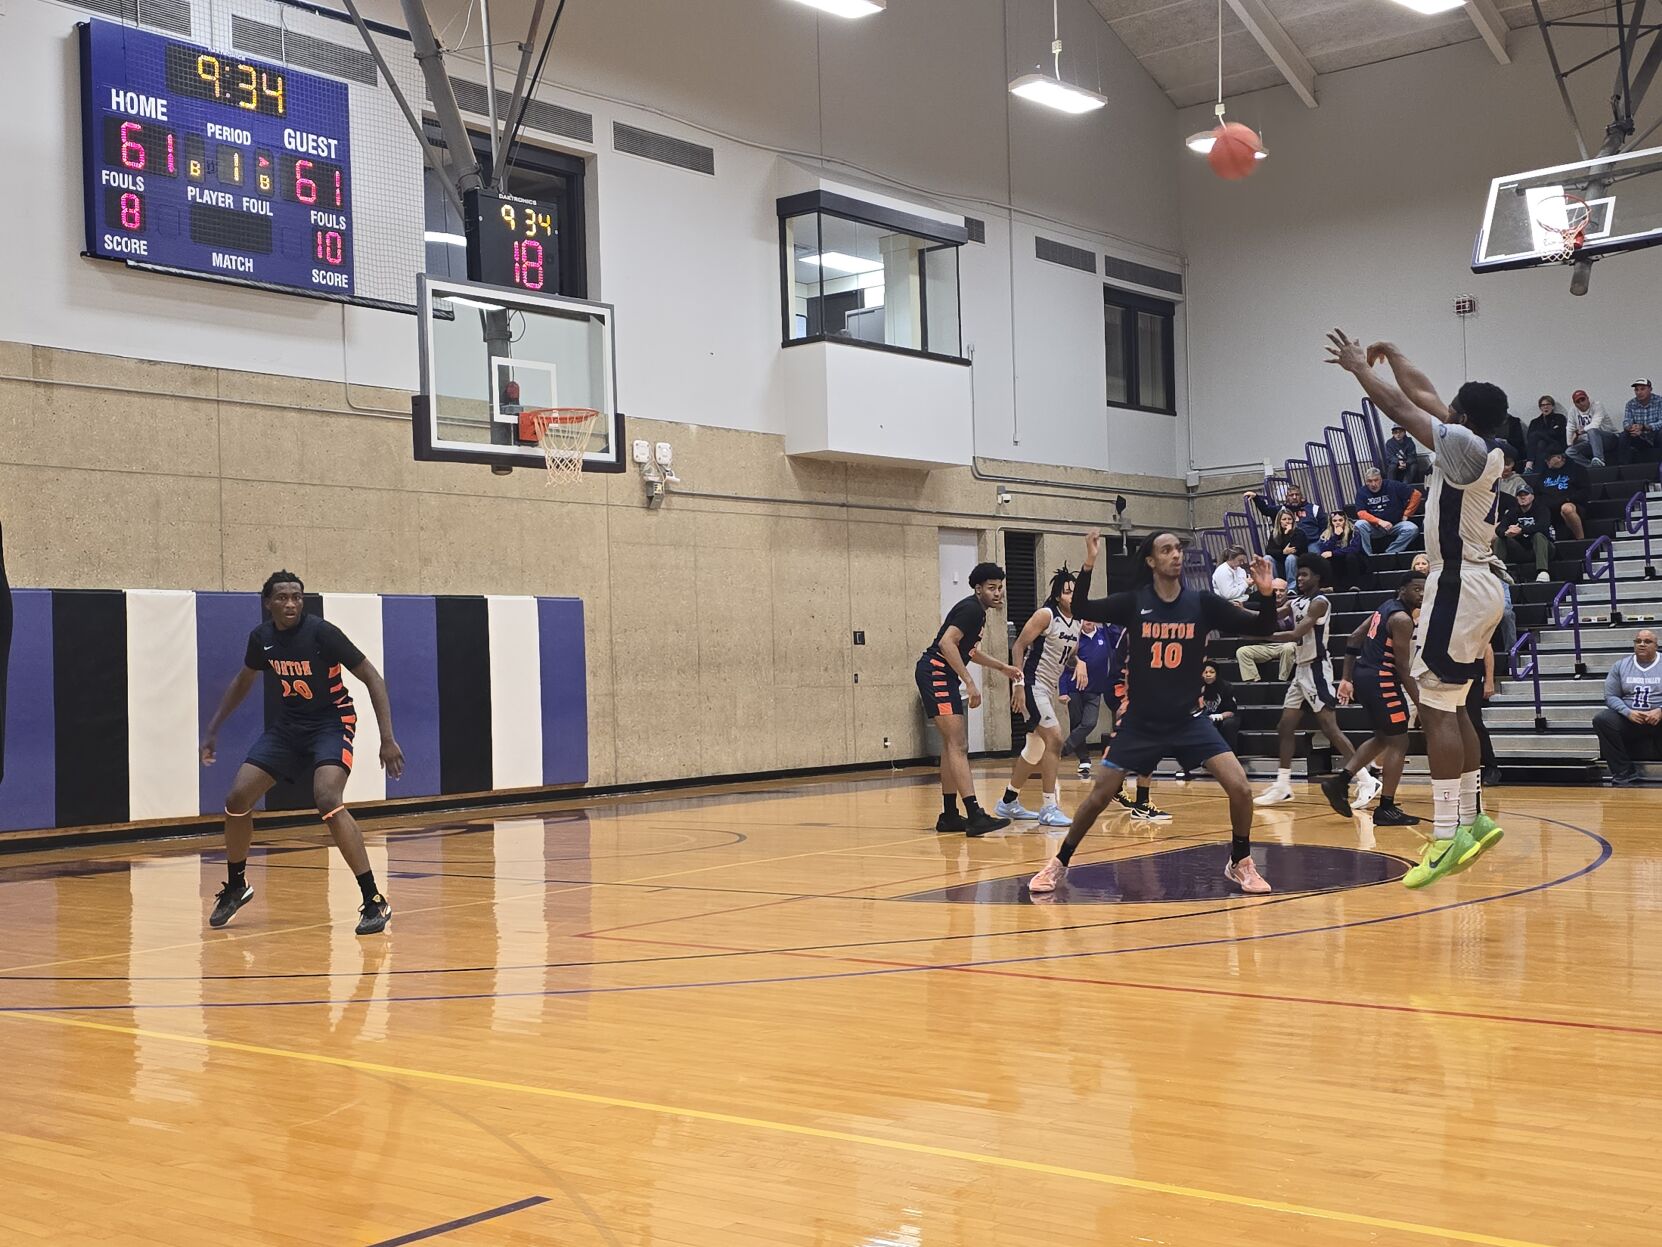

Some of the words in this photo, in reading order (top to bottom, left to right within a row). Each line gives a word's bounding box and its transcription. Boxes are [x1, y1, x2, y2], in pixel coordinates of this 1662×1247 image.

[197, 54, 283, 113] 9:34
[111, 88, 168, 121] HOME
[121, 121, 175, 173] 61
[207, 122, 251, 146] PERIOD
[284, 128, 338, 159] GUEST
[101, 169, 145, 192] FOULS
[190, 159, 201, 177] B
[233, 152, 240, 182] 1
[259, 174, 270, 190] B
[295, 159, 341, 206] 61
[120, 192, 142, 230] 8
[187, 186, 234, 209] PLAYER
[242, 197, 274, 217] FOUL
[310, 210, 347, 231] FOULS
[103, 234, 149, 256] SCORE
[316, 230, 342, 265] 10
[211, 252, 254, 273] MATCH
[513, 239, 544, 289] 18
[311, 268, 349, 289] SCORE
[1141, 621, 1196, 640] MORTON
[1150, 641, 1183, 669] 10
